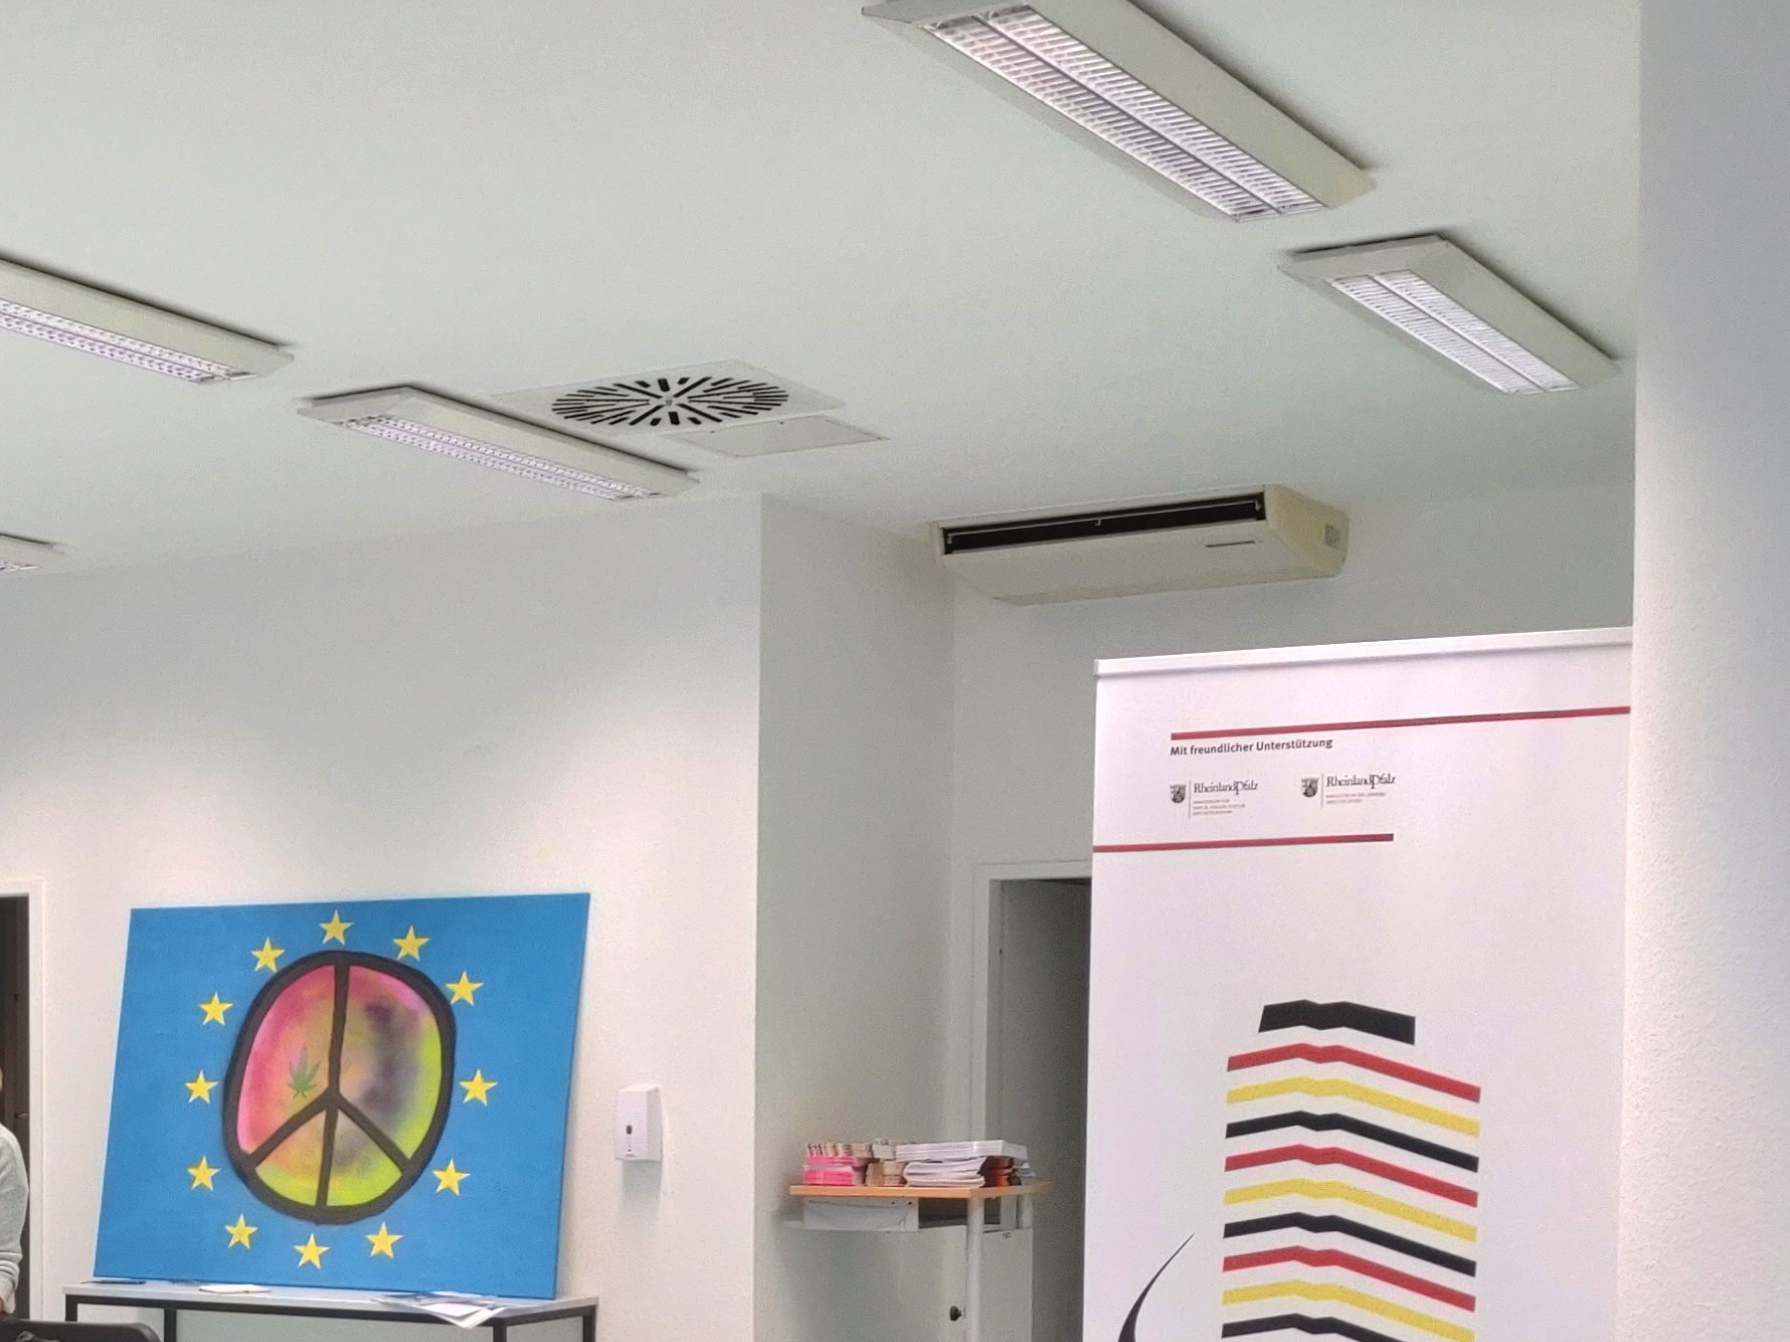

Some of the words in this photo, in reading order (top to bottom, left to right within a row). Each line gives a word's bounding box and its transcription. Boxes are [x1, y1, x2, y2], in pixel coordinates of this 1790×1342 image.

[1170, 746, 1187, 756] Mit
[1190, 743, 1253, 754] freundlicher
[1256, 739, 1333, 751] Unterstützung
